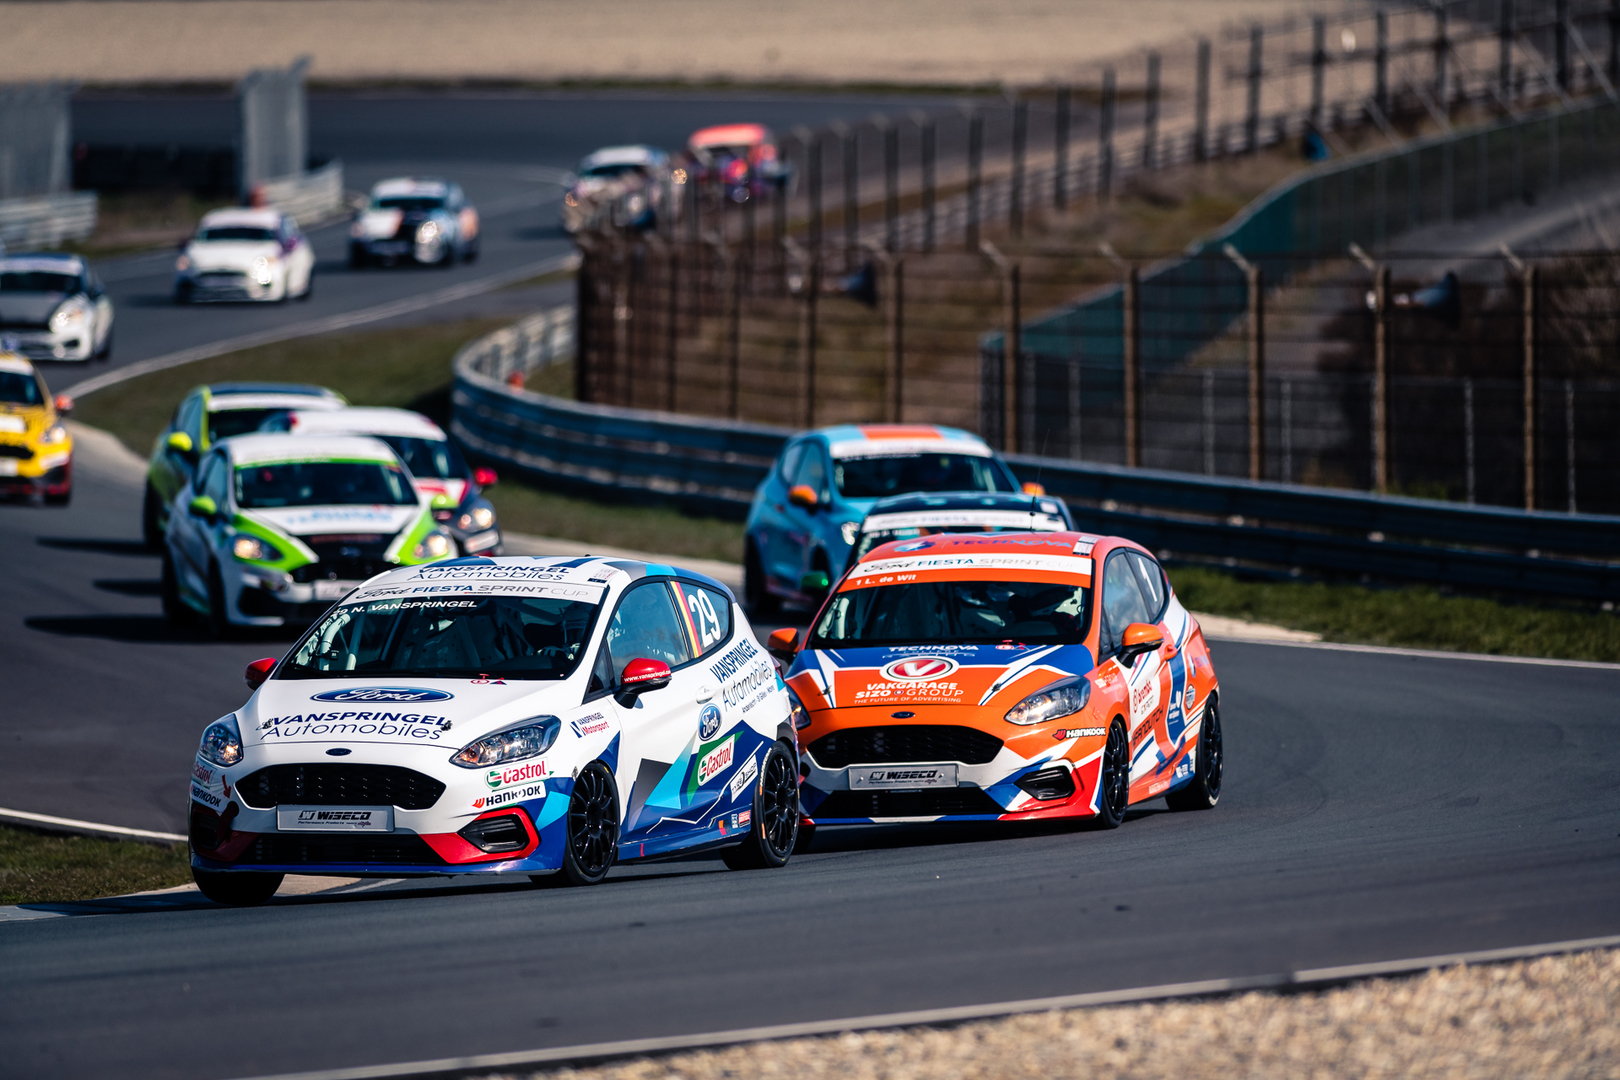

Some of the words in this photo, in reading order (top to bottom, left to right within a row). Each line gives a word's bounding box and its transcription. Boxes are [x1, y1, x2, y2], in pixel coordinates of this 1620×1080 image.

[952, 540, 1072, 548] TECHNOVA
[419, 565, 570, 574] VANSPRINGEL
[917, 559, 974, 567] FIESTA
[407, 570, 565, 581] Automobiles
[355, 586, 412, 599] Ford
[411, 585, 474, 594] FIESTA
[477, 585, 549, 594] SPRINT
[550, 588, 589, 597] CUP
[350, 606, 366, 614] N.
[371, 600, 478, 612] VANSPRINGEL
[688, 588, 721, 648] 29
[709, 637, 758, 684] VANSPRINGEL
[722, 659, 773, 712] Automobiles
[867, 682, 958, 691] VAKGARAGE
[334, 687, 429, 701] Ford
[855, 689, 892, 699] SIZO
[906, 688, 964, 697] GROUP
[273, 711, 449, 726] VANSPRINGEL
[701, 708, 720, 738] Ford
[260, 722, 443, 740] Automobiles
[706, 742, 732, 777] Castrol
[503, 760, 547, 784] Castrol
